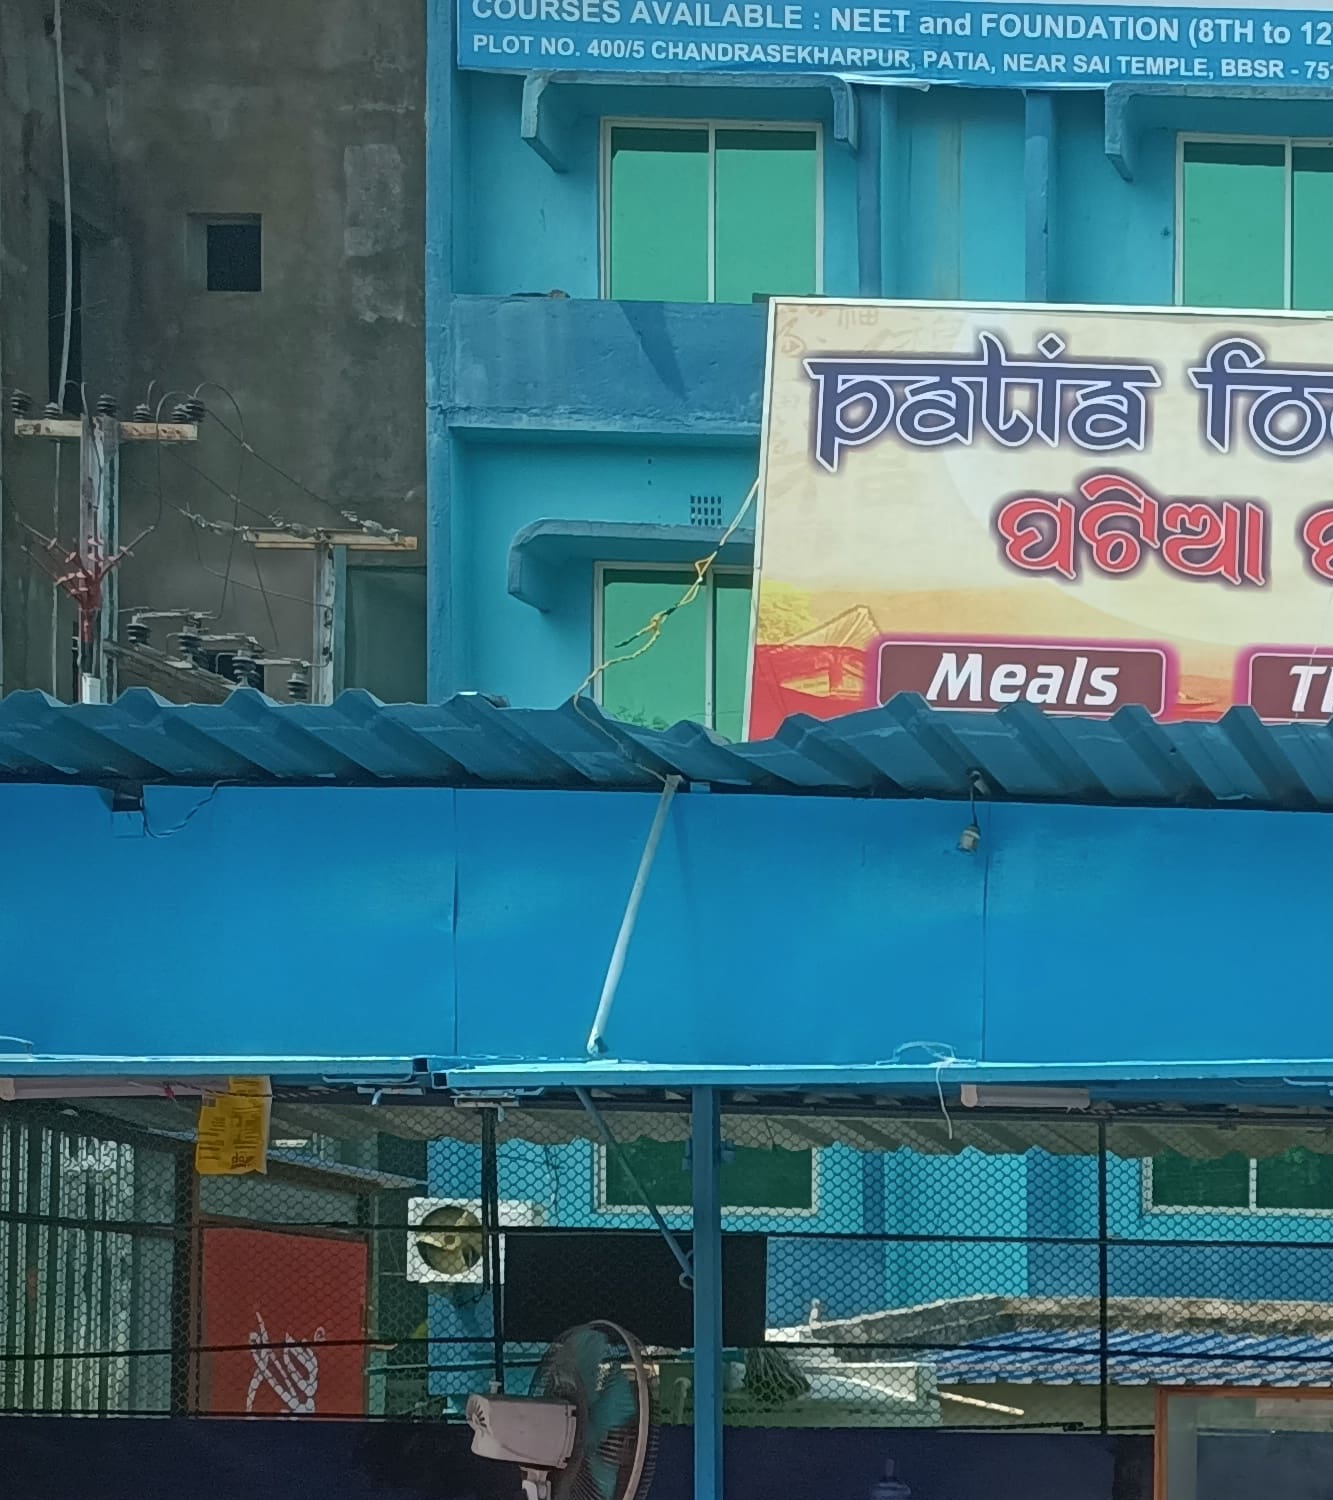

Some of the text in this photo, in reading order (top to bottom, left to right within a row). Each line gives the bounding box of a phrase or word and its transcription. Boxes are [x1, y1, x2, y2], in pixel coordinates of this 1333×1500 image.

[473, 0, 621, 24] COURSES
[630, 0, 801, 30] AVAILABLE
[831, 7, 910, 33] NEET
[919, 12, 972, 37] and
[981, 13, 1180, 42] FOUNDATION
[1188, 17, 1255, 49] (8TH
[1263, 21, 1291, 44] to
[473, 34, 534, 54] PLOT
[540, 36, 581, 57] NO.
[587, 39, 645, 60] 400/5
[651, 40, 915, 71] CHANDRASEKHARPUR,
[923, 51, 996, 74] PATIA,
[1003, 53, 1067, 74] NEAR
[1073, 55, 1110, 75] SAI
[1116, 56, 1214, 79] TEMPLE,
[1221, 60, 1284, 78] BBSR
[803, 332, 1160, 473] patia
[927, 651, 1120, 706] Meals
